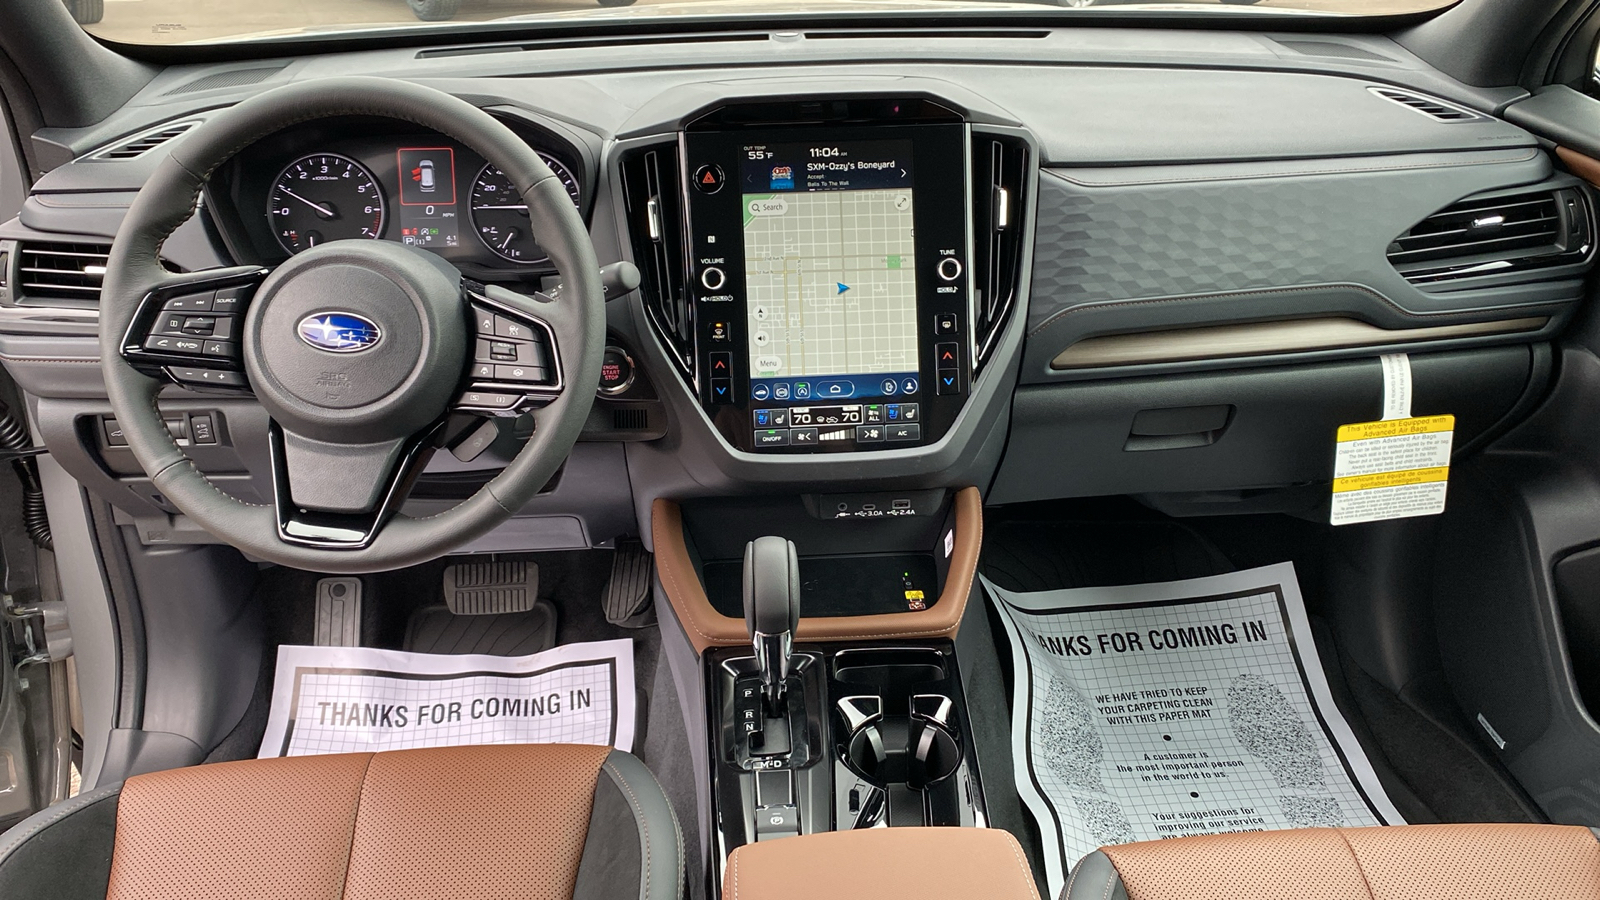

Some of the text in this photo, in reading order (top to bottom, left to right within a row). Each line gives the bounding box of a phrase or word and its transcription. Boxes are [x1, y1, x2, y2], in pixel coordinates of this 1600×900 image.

[748, 151, 764, 160] 55
[810, 147, 839, 157] 11:04
[807, 160, 895, 171] SXM-Ozzy's Boneyard
[426, 205, 434, 215] 0
[321, 372, 348, 380] SRS
[794, 414, 811, 424] 70
[842, 412, 859, 422] 70
[1399, 418, 1429, 427] Equipped
[1363, 428, 1395, 437] Advanced
[1097, 631, 1144, 654] FOR
[1149, 623, 1237, 650] COMING
[1242, 620, 1268, 642] IN
[1095, 686, 1208, 703] WE HAVE TRIED TO KEEP
[318, 688, 591, 728] THANKS FOR COMING IN
[1098, 698, 1213, 715] YOUR CARPETING CLEAN
[1107, 709, 1212, 725] WITH THIS PAPER MAT
[1153, 752, 1197, 761] customer
[1136, 763, 1160, 772] most
[1162, 761, 1209, 771] important
[1211, 760, 1244, 769] person
[1172, 771, 1199, 780] world
[1152, 813, 1176, 821] Your
[1179, 809, 1238, 820] suggestions
[1154, 822, 1206, 832] improving
[1228, 817, 1264, 826] service
